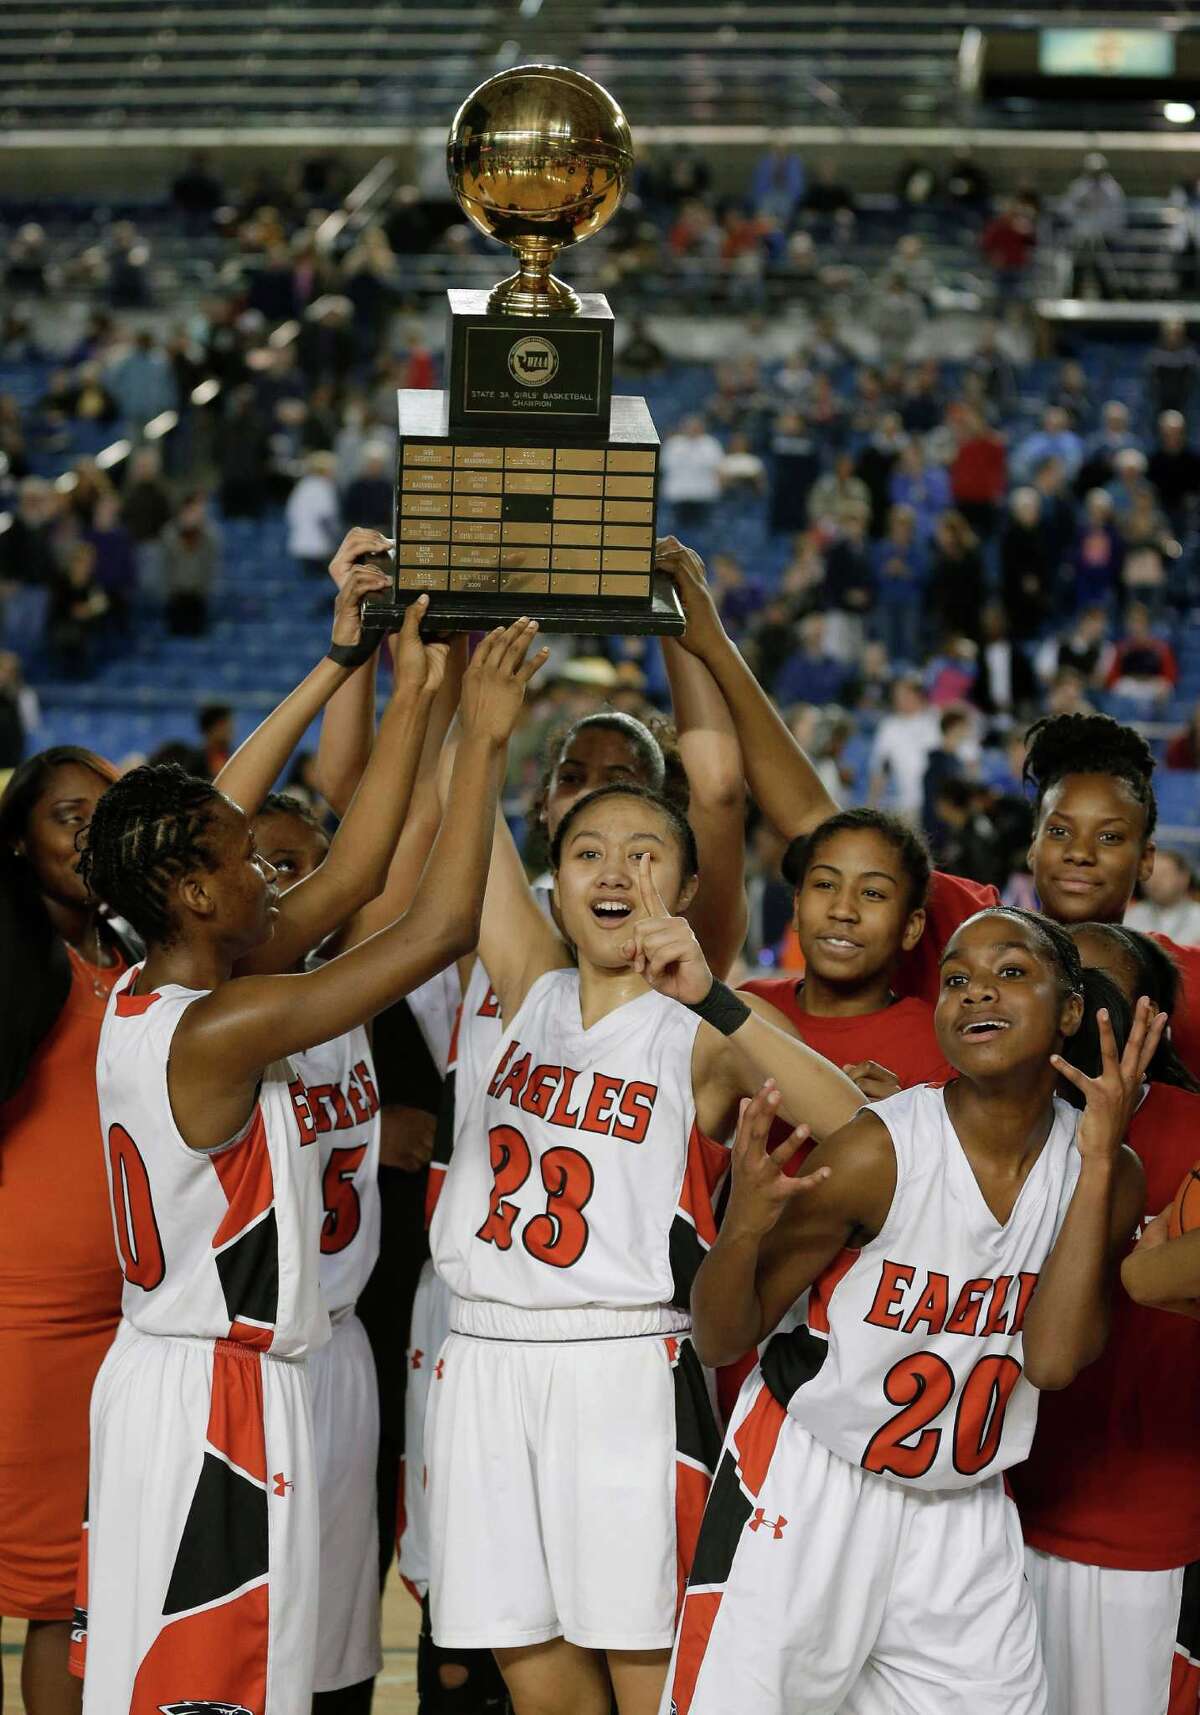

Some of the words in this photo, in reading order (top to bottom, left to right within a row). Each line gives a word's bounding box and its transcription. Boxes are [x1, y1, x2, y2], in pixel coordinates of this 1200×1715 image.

[471, 390, 495, 399] STATE
[500, 391, 510, 399] 3A
[543, 392, 593, 401] BASKETBALL
[512, 400, 552, 408] CHAMPION
[487, 1039, 658, 1144] EAGLES
[475, 1124, 595, 1268] 23
[863, 1259, 1040, 1337] EAGL
[860, 1350, 1023, 1479] 20
